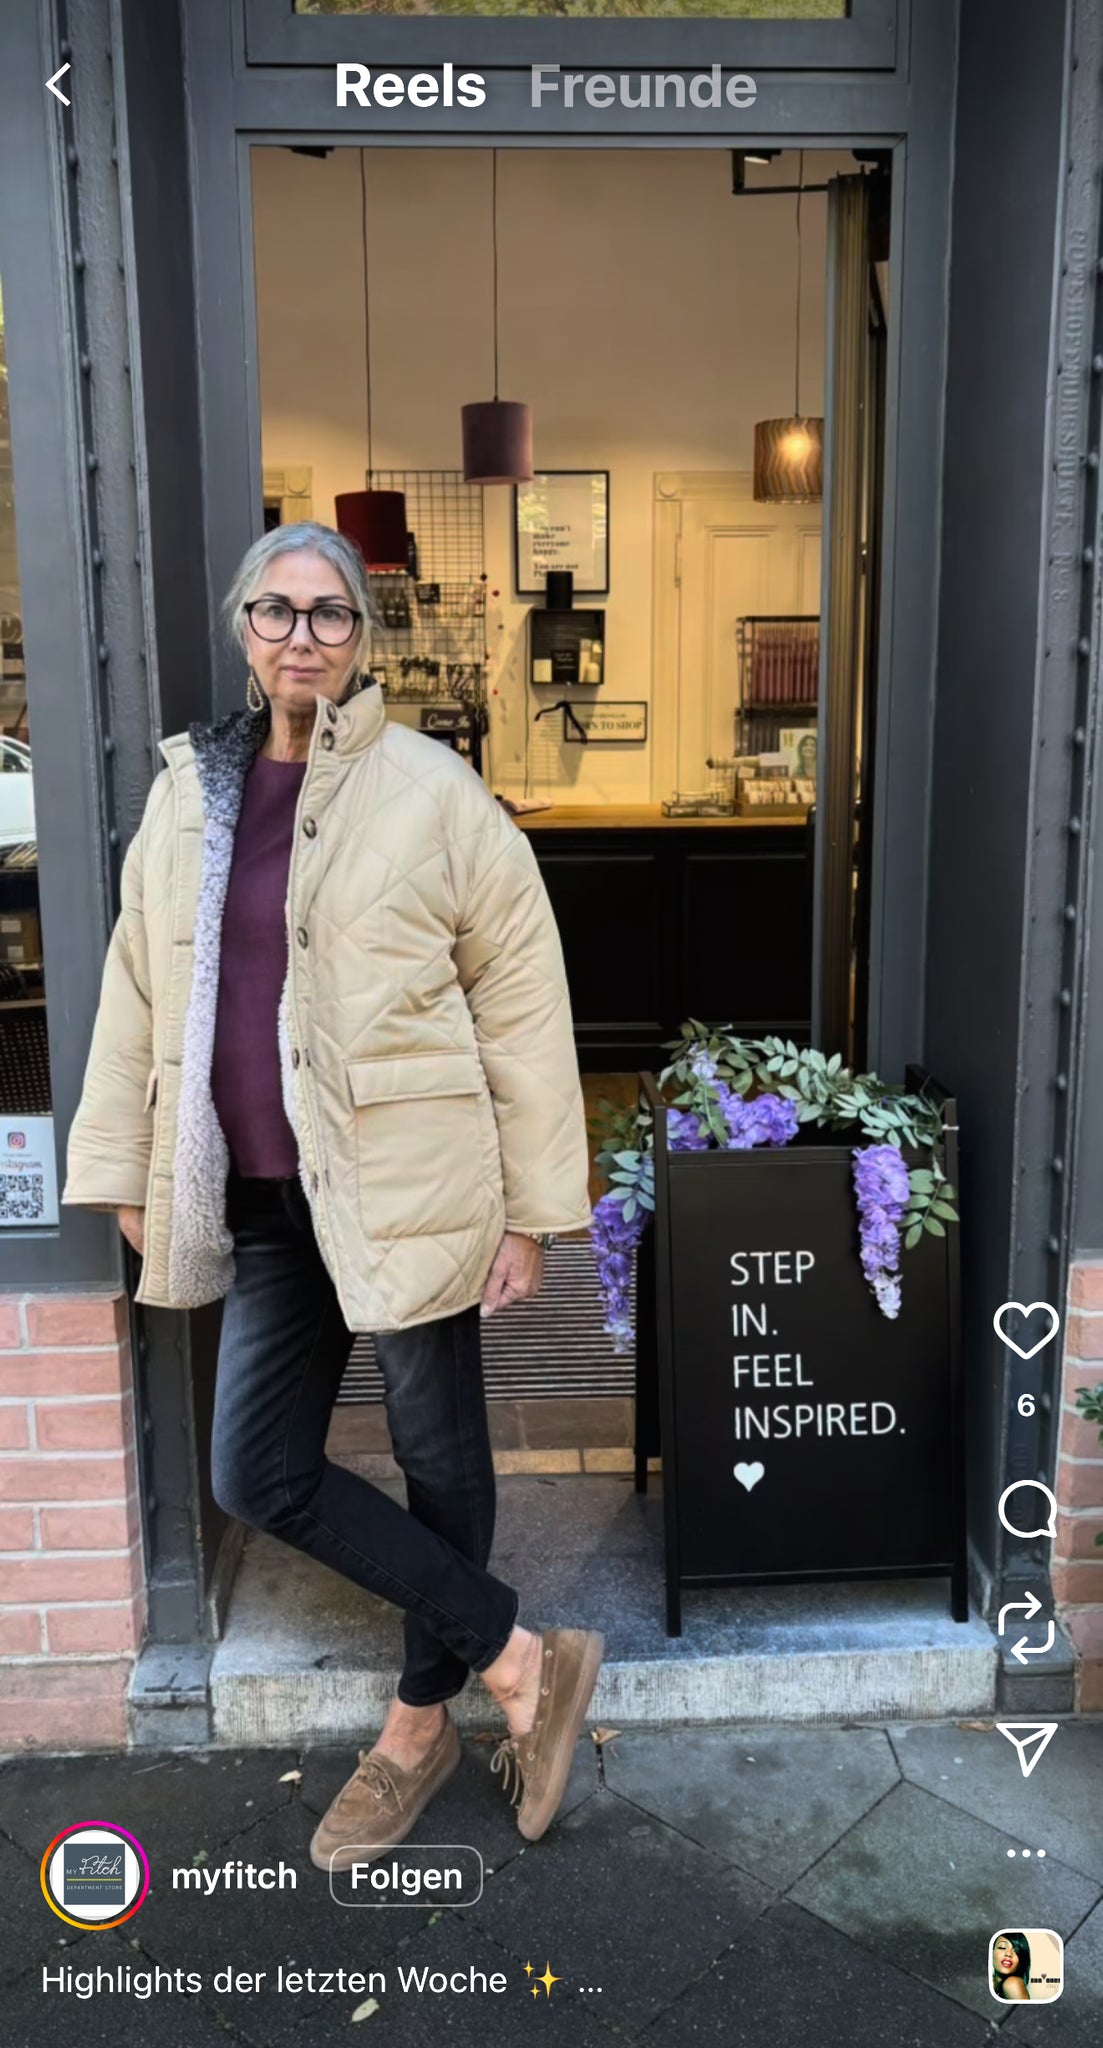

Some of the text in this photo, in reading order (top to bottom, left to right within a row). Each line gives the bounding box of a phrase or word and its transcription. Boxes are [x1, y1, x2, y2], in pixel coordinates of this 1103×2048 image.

[601, 721, 614, 730] TO
[616, 721, 642, 730] SHOP
[730, 1250, 816, 1286] STEP
[731, 1303, 779, 1337] IN.
[733, 1353, 814, 1389] FEEL
[734, 1401, 907, 1440] INSPIRED.
